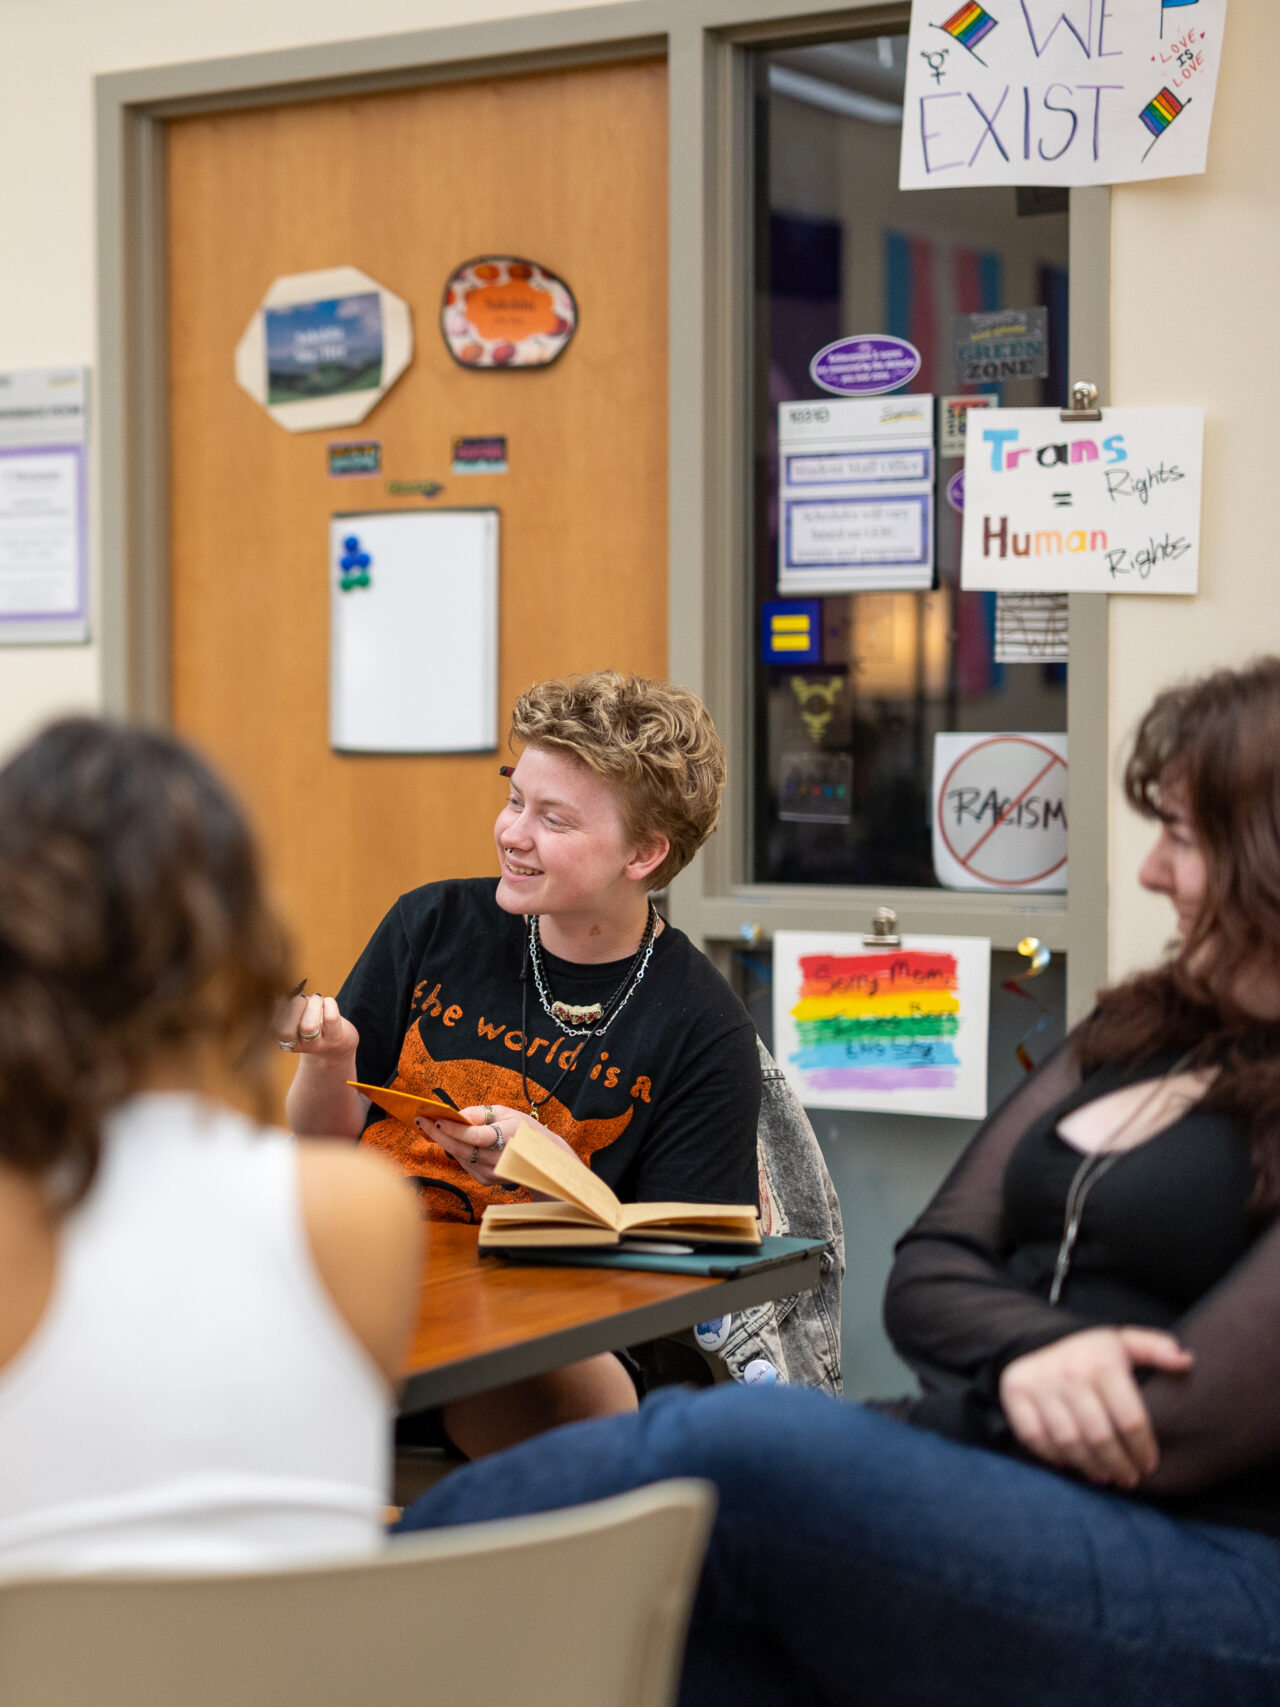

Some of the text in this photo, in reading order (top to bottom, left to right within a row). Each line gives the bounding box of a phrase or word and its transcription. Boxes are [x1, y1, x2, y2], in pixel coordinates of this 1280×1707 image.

[1020, 0, 1124, 59] WE
[1159, 28, 1196, 64] LOVE
[1172, 50, 1204, 88] LOVE
[1176, 49, 1194, 68] IS
[920, 83, 1124, 174] EXIST
[957, 341, 1043, 362] GREEN
[967, 360, 1033, 379] ZONE
[982, 428, 1129, 473] Trans
[1104, 462, 1186, 504] Rights
[982, 516, 1109, 560] Human
[1104, 532, 1193, 580] Rights
[946, 785, 1068, 831] RACISM
[814, 962, 880, 999] Sorry
[411, 980, 464, 1027] the
[477, 1016, 584, 1072] world
[589, 1051, 621, 1088] is
